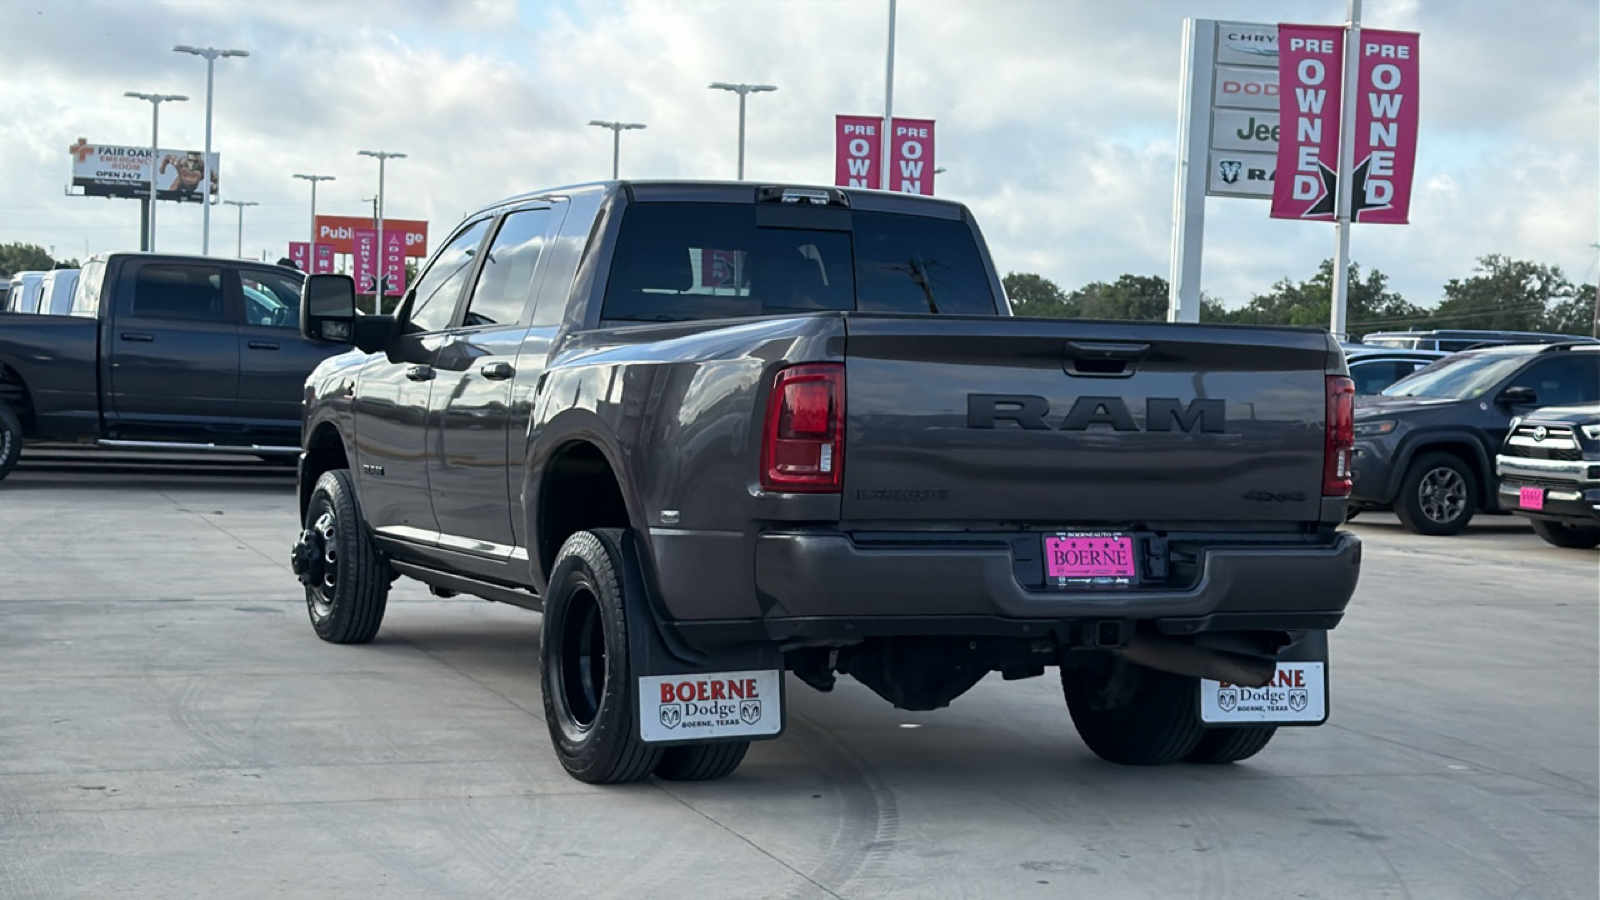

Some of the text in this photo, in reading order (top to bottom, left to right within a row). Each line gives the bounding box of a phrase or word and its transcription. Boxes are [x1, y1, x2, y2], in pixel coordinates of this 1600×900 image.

[1228, 33, 1276, 43] CHRY
[1290, 38, 1334, 54] PRE
[1365, 43, 1410, 60] PRE
[1223, 81, 1280, 96] DOD
[844, 124, 875, 136] PRE
[896, 126, 928, 138] PRE
[1237, 117, 1280, 142] Jee
[1292, 59, 1326, 201] OWNED
[1364, 63, 1403, 205] OWNED
[98, 147, 125, 157] FAIR
[100, 155, 152, 165] EMERGENC
[111, 163, 141, 171] ROOM
[847, 138, 871, 190] OWN
[899, 140, 924, 195] OWN
[95, 170, 141, 180] OPEN 24/7
[967, 393, 1226, 434] RAM
[1054, 550, 1128, 566] BOERNE
[660, 679, 759, 703] BOERNE
[1240, 689, 1285, 705] Dodge
[685, 701, 736, 718] Dodge
